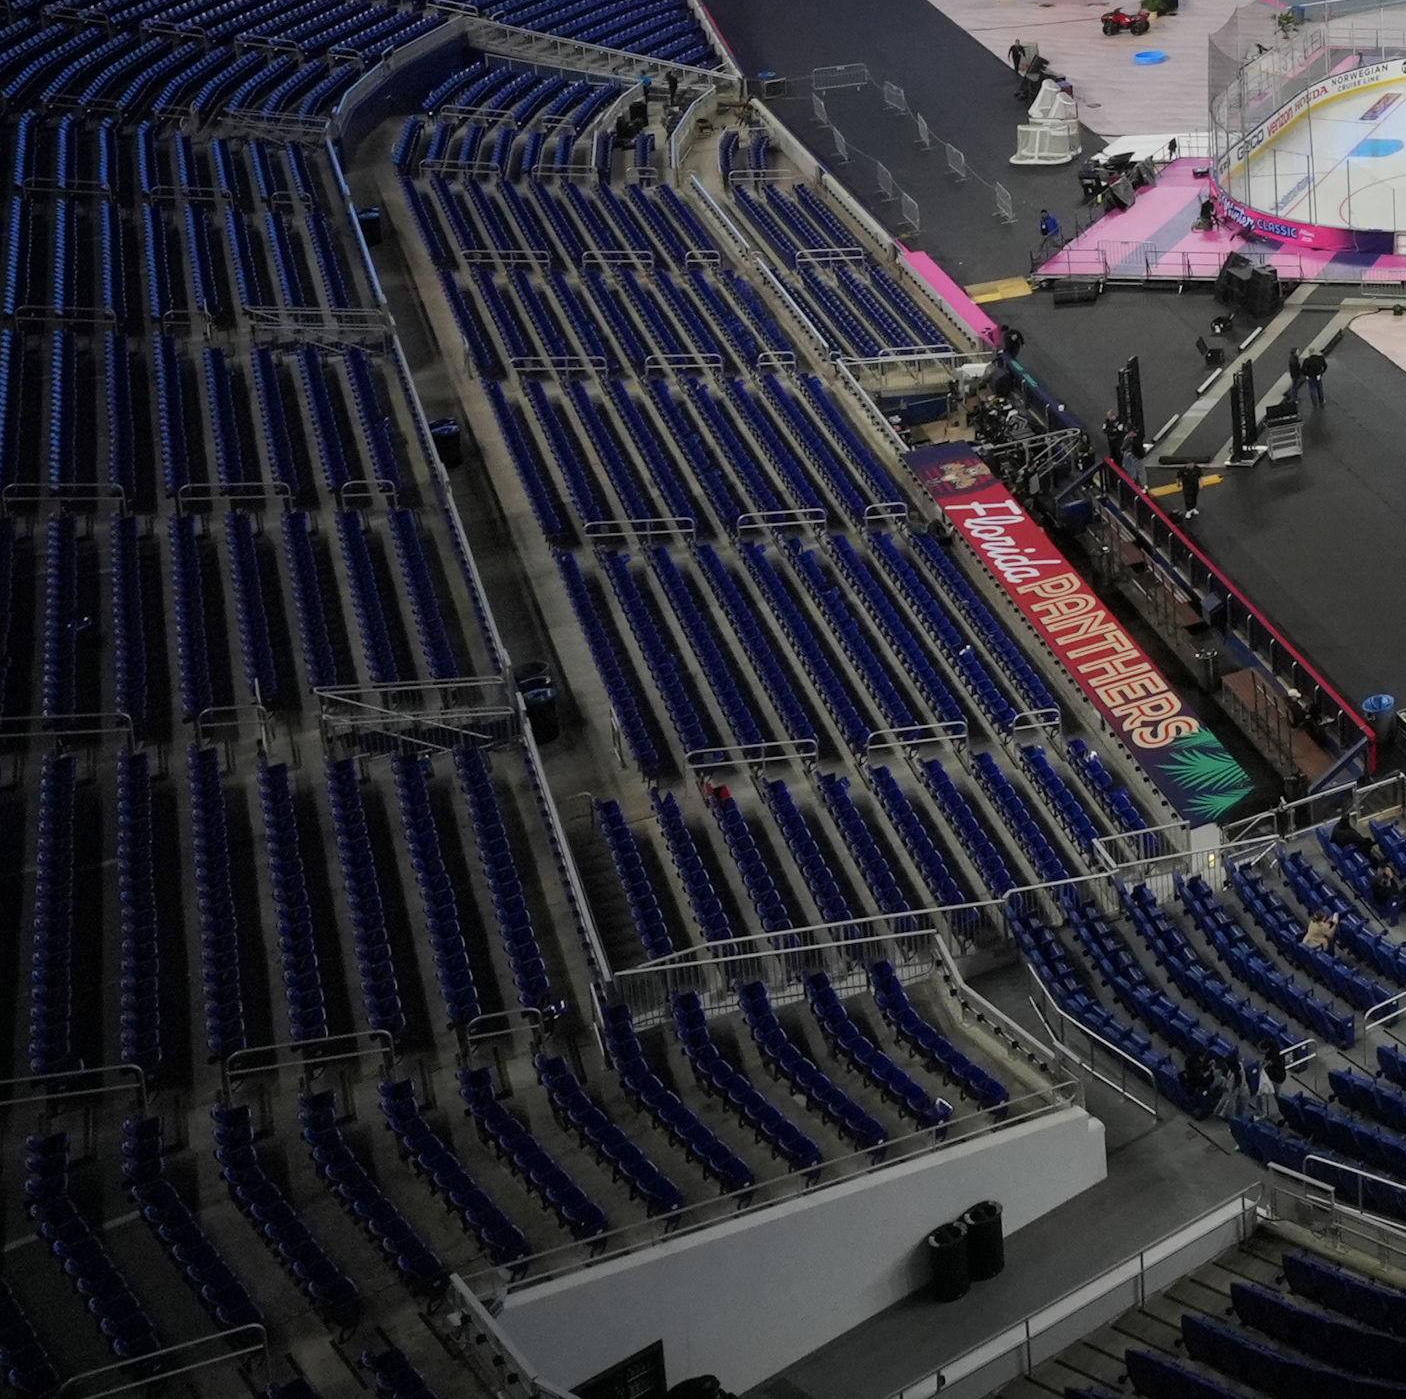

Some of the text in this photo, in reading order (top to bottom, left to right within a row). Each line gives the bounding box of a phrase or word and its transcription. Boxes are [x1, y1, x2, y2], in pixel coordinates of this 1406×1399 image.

[1330, 64, 1389, 86] NORWEGIAN
[1337, 75, 1380, 93] CRUISE LINE
[1294, 85, 1329, 113] HONDA
[1266, 106, 1294, 138] verizon
[1256, 218, 1299, 239] CLASSIC
[945, 498, 1201, 750] Florida PANTHERS
